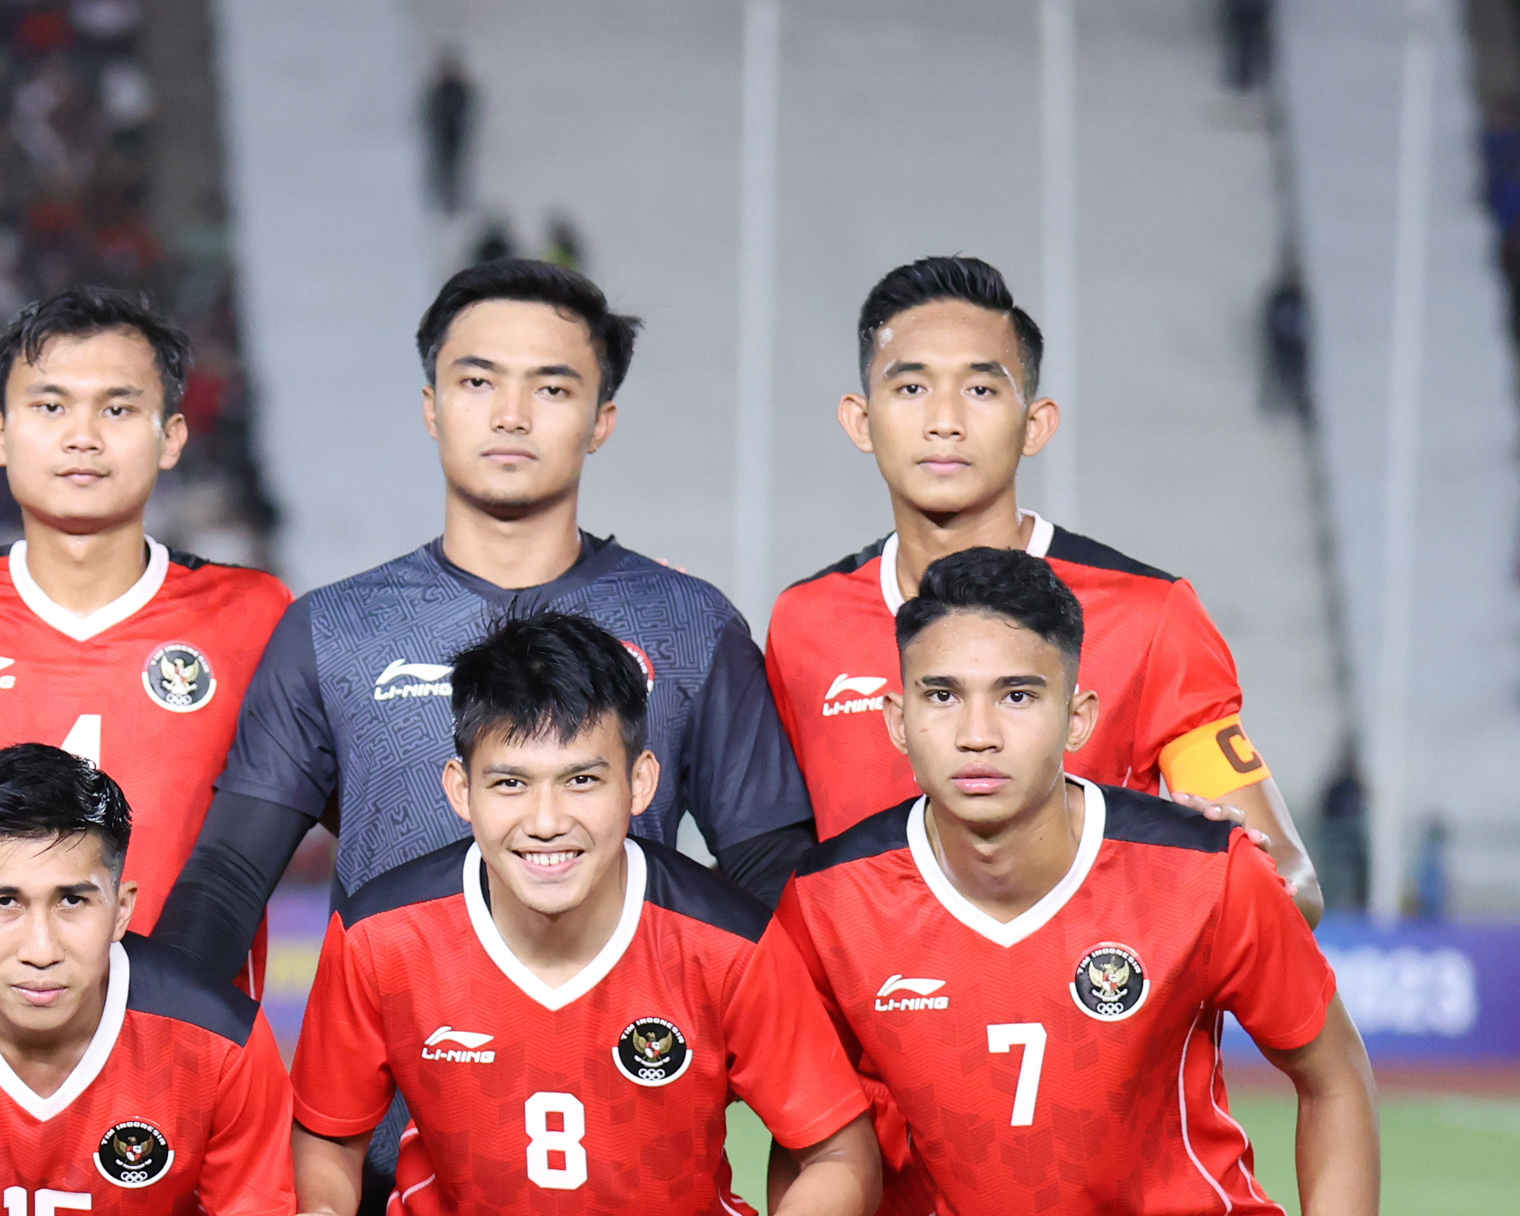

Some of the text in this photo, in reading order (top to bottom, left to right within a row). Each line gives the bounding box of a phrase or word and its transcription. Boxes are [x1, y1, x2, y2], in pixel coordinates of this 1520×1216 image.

[1216, 724, 1263, 773] C
[874, 997, 950, 1012] LI-NING
[421, 1048, 496, 1064] LI-NING
[986, 1022, 1048, 1126] 7
[524, 1091, 588, 1190] 8
